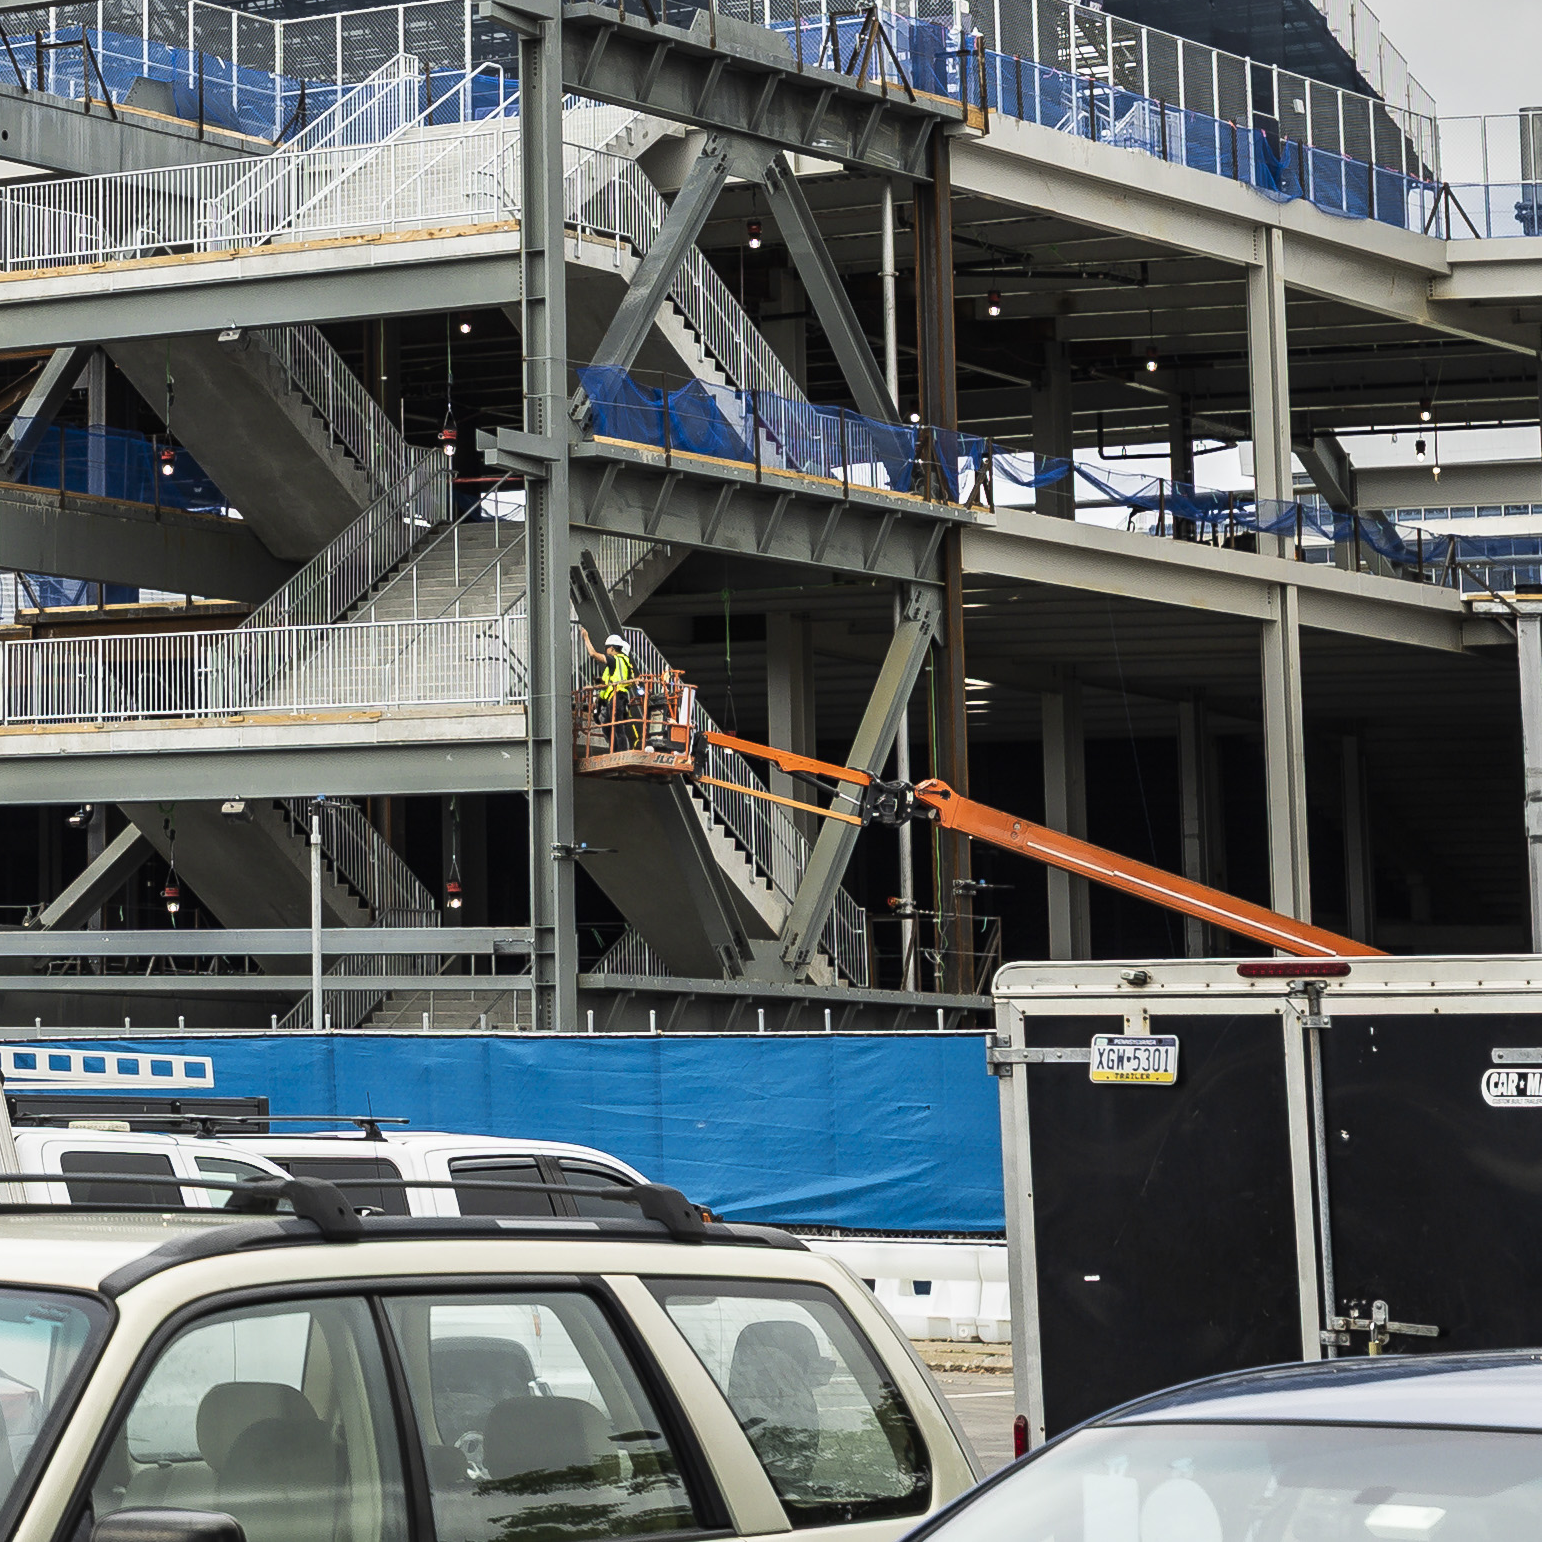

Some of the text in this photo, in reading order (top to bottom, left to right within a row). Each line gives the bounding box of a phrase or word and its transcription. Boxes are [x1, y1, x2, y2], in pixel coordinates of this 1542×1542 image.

[653, 754, 675, 765] JLG
[1114, 1072, 1151, 1080] TRAILER
[1489, 1072, 1542, 1096] CAR M
